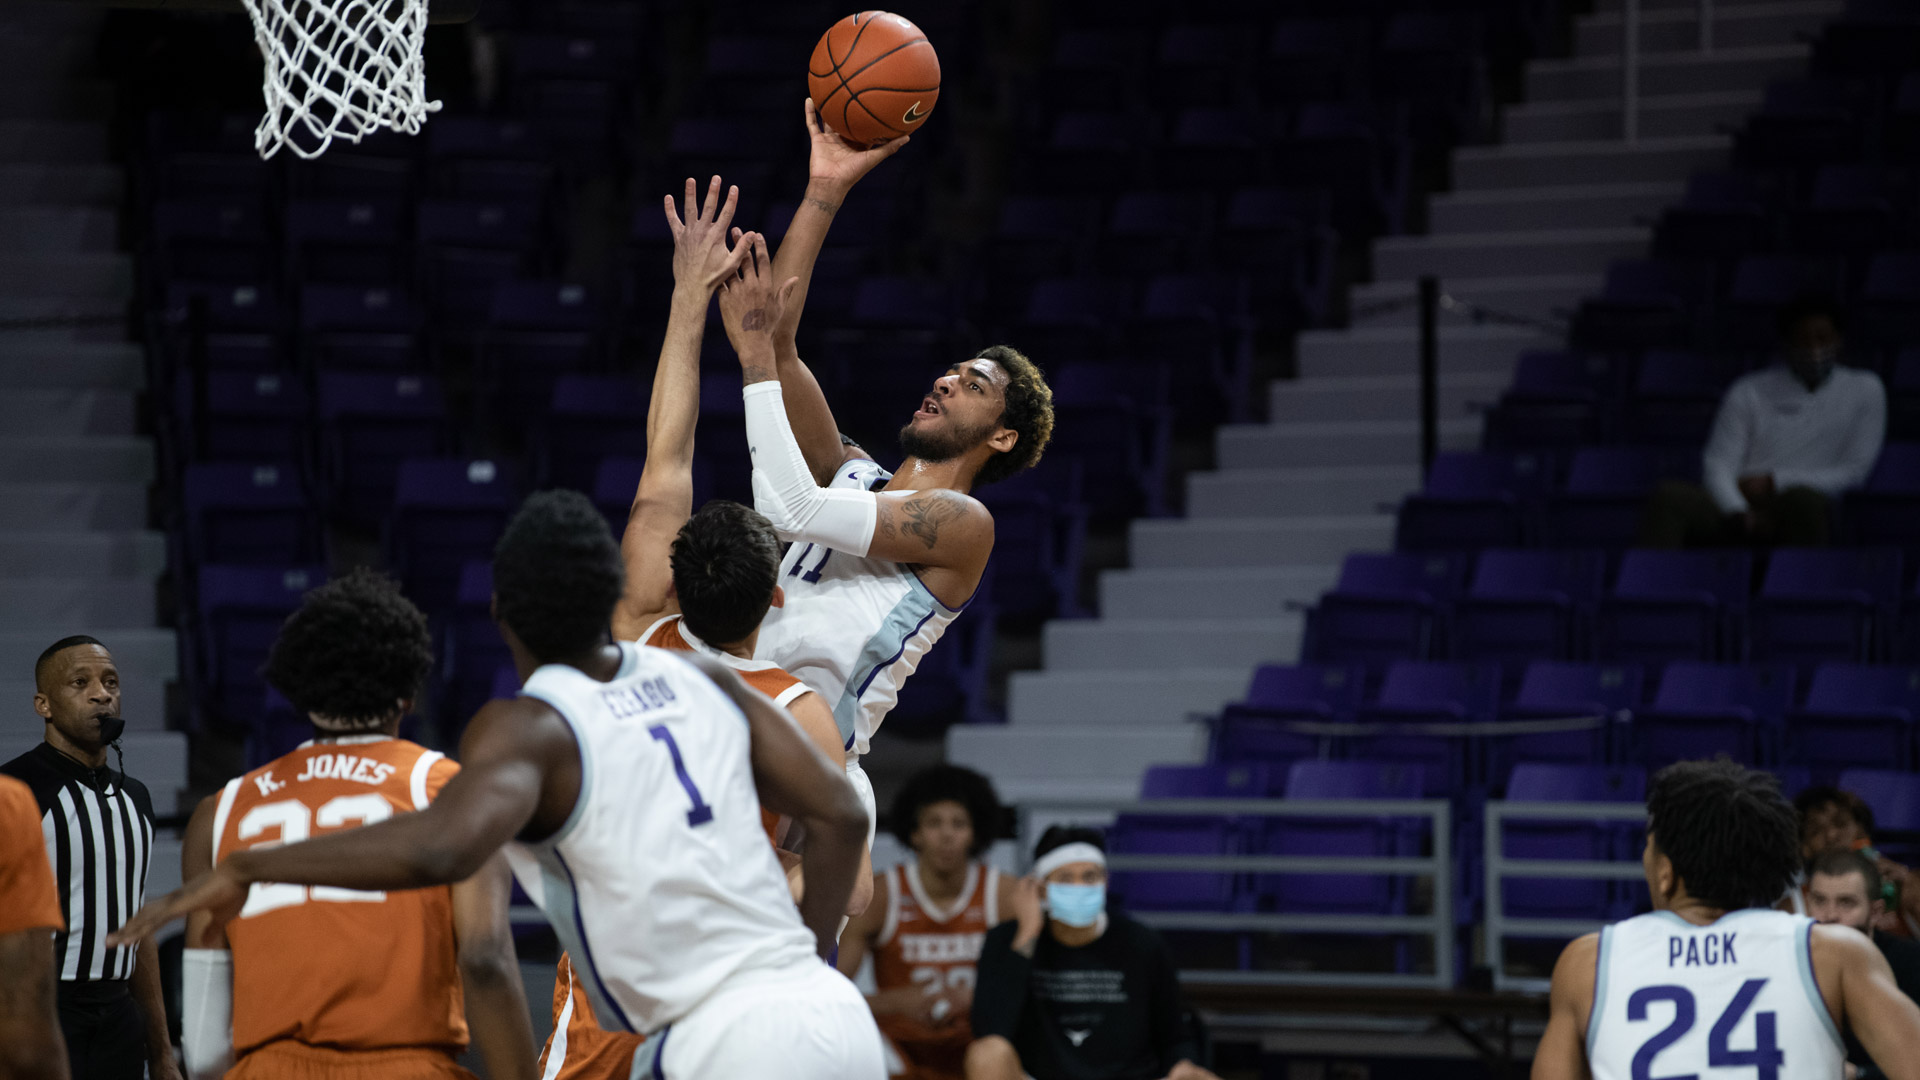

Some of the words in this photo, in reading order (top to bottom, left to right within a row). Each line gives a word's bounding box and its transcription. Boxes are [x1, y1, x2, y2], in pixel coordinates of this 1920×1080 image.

[254, 770, 286, 797] K.
[297, 753, 396, 785] JONES
[648, 725, 714, 829] 1
[1669, 932, 1738, 968] PACK
[1627, 977, 1785, 1080] 24
